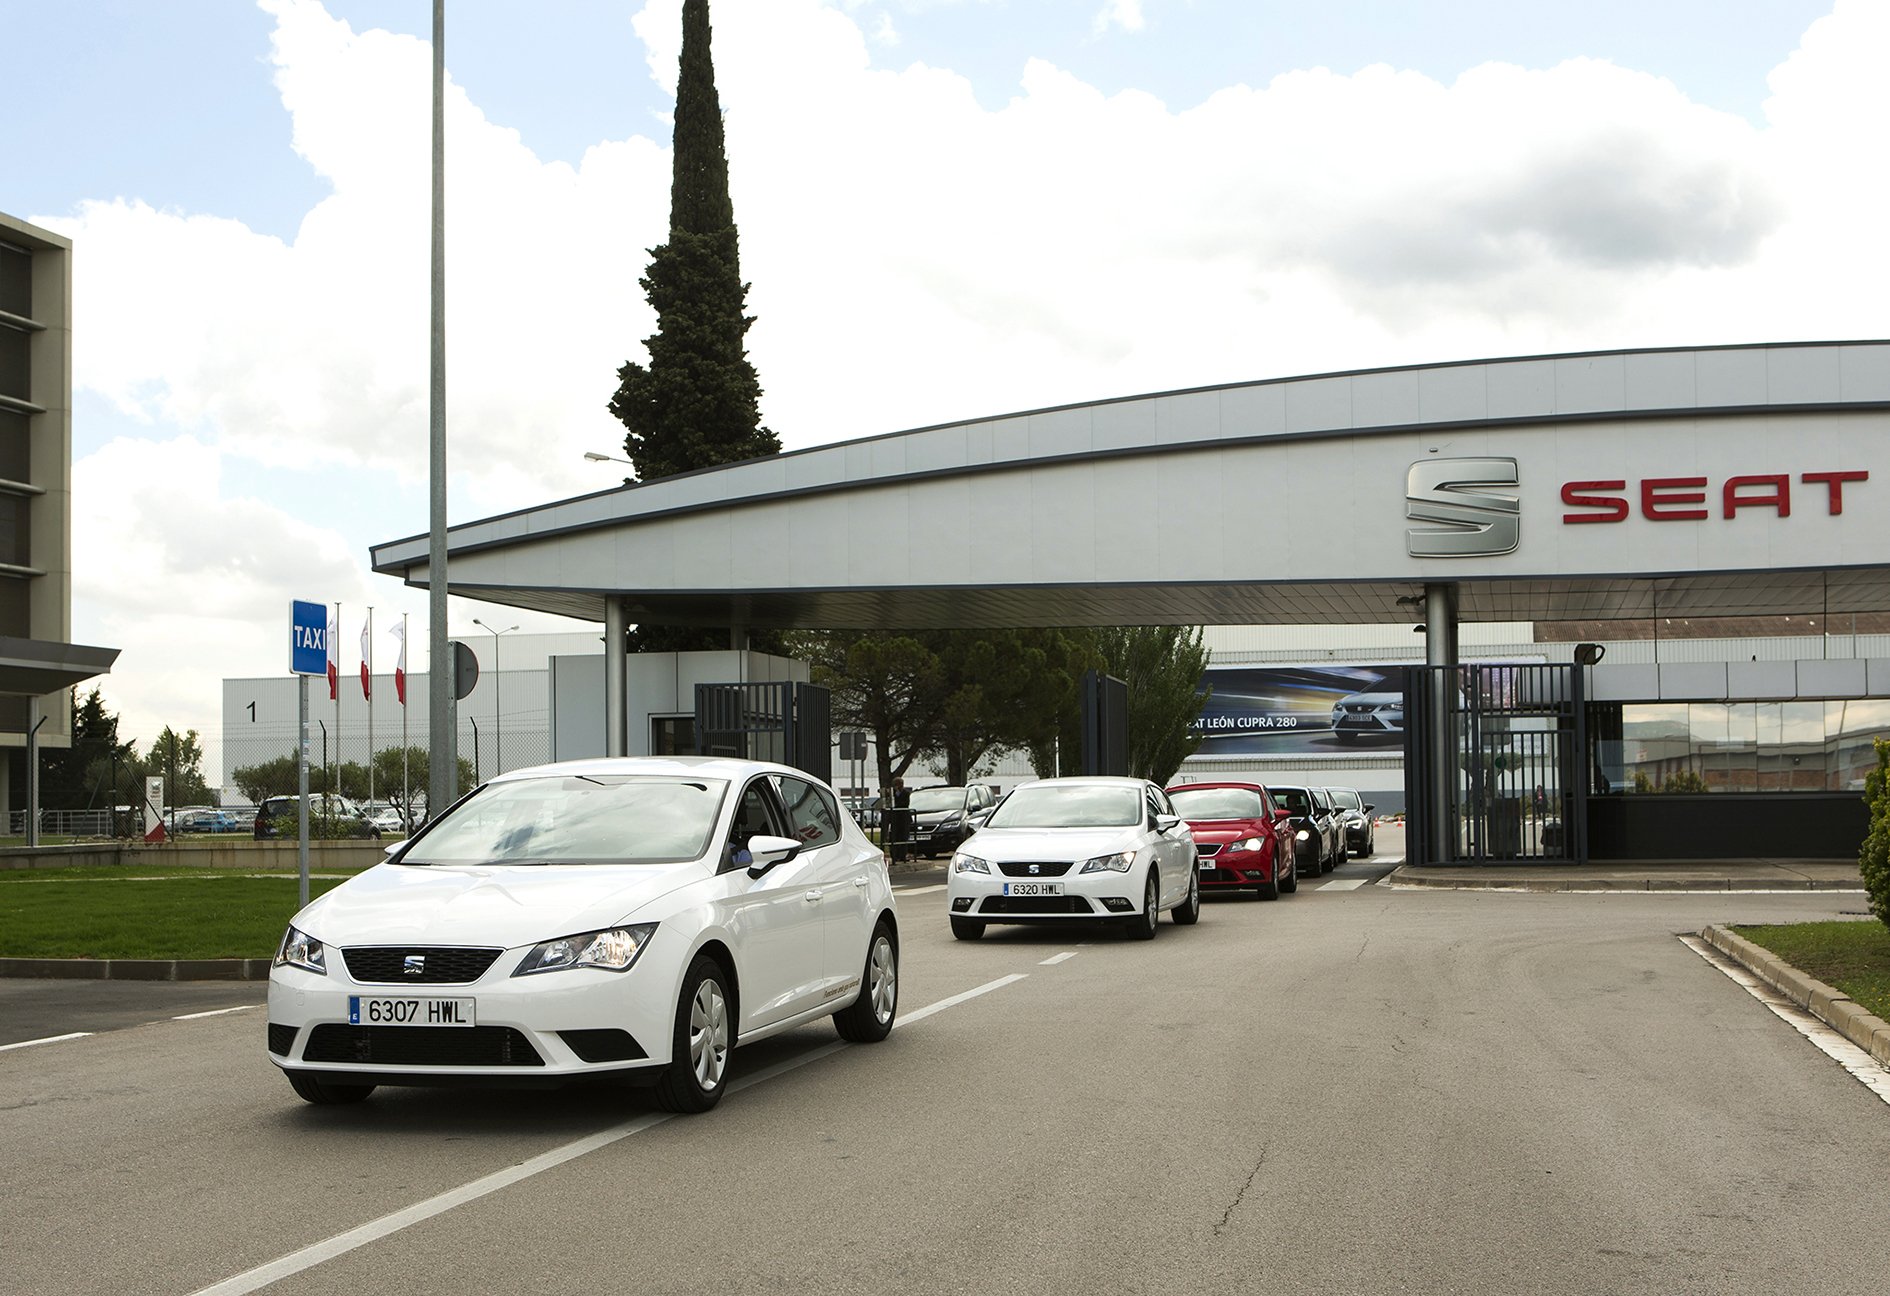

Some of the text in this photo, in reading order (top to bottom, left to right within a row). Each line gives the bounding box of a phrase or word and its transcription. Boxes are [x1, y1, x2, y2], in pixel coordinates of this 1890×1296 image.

[1560, 471, 1869, 525] SEAT
[294, 625, 326, 651] TAXI
[246, 700, 256, 723] 1
[1207, 715, 1235, 728] LEÓN
[1237, 717, 1274, 728] CUPRA
[1276, 716, 1298, 727] 280
[1013, 884, 1061, 895] 6320 HWL
[369, 1000, 419, 1022] 6307
[428, 1001, 467, 1023] HWL
